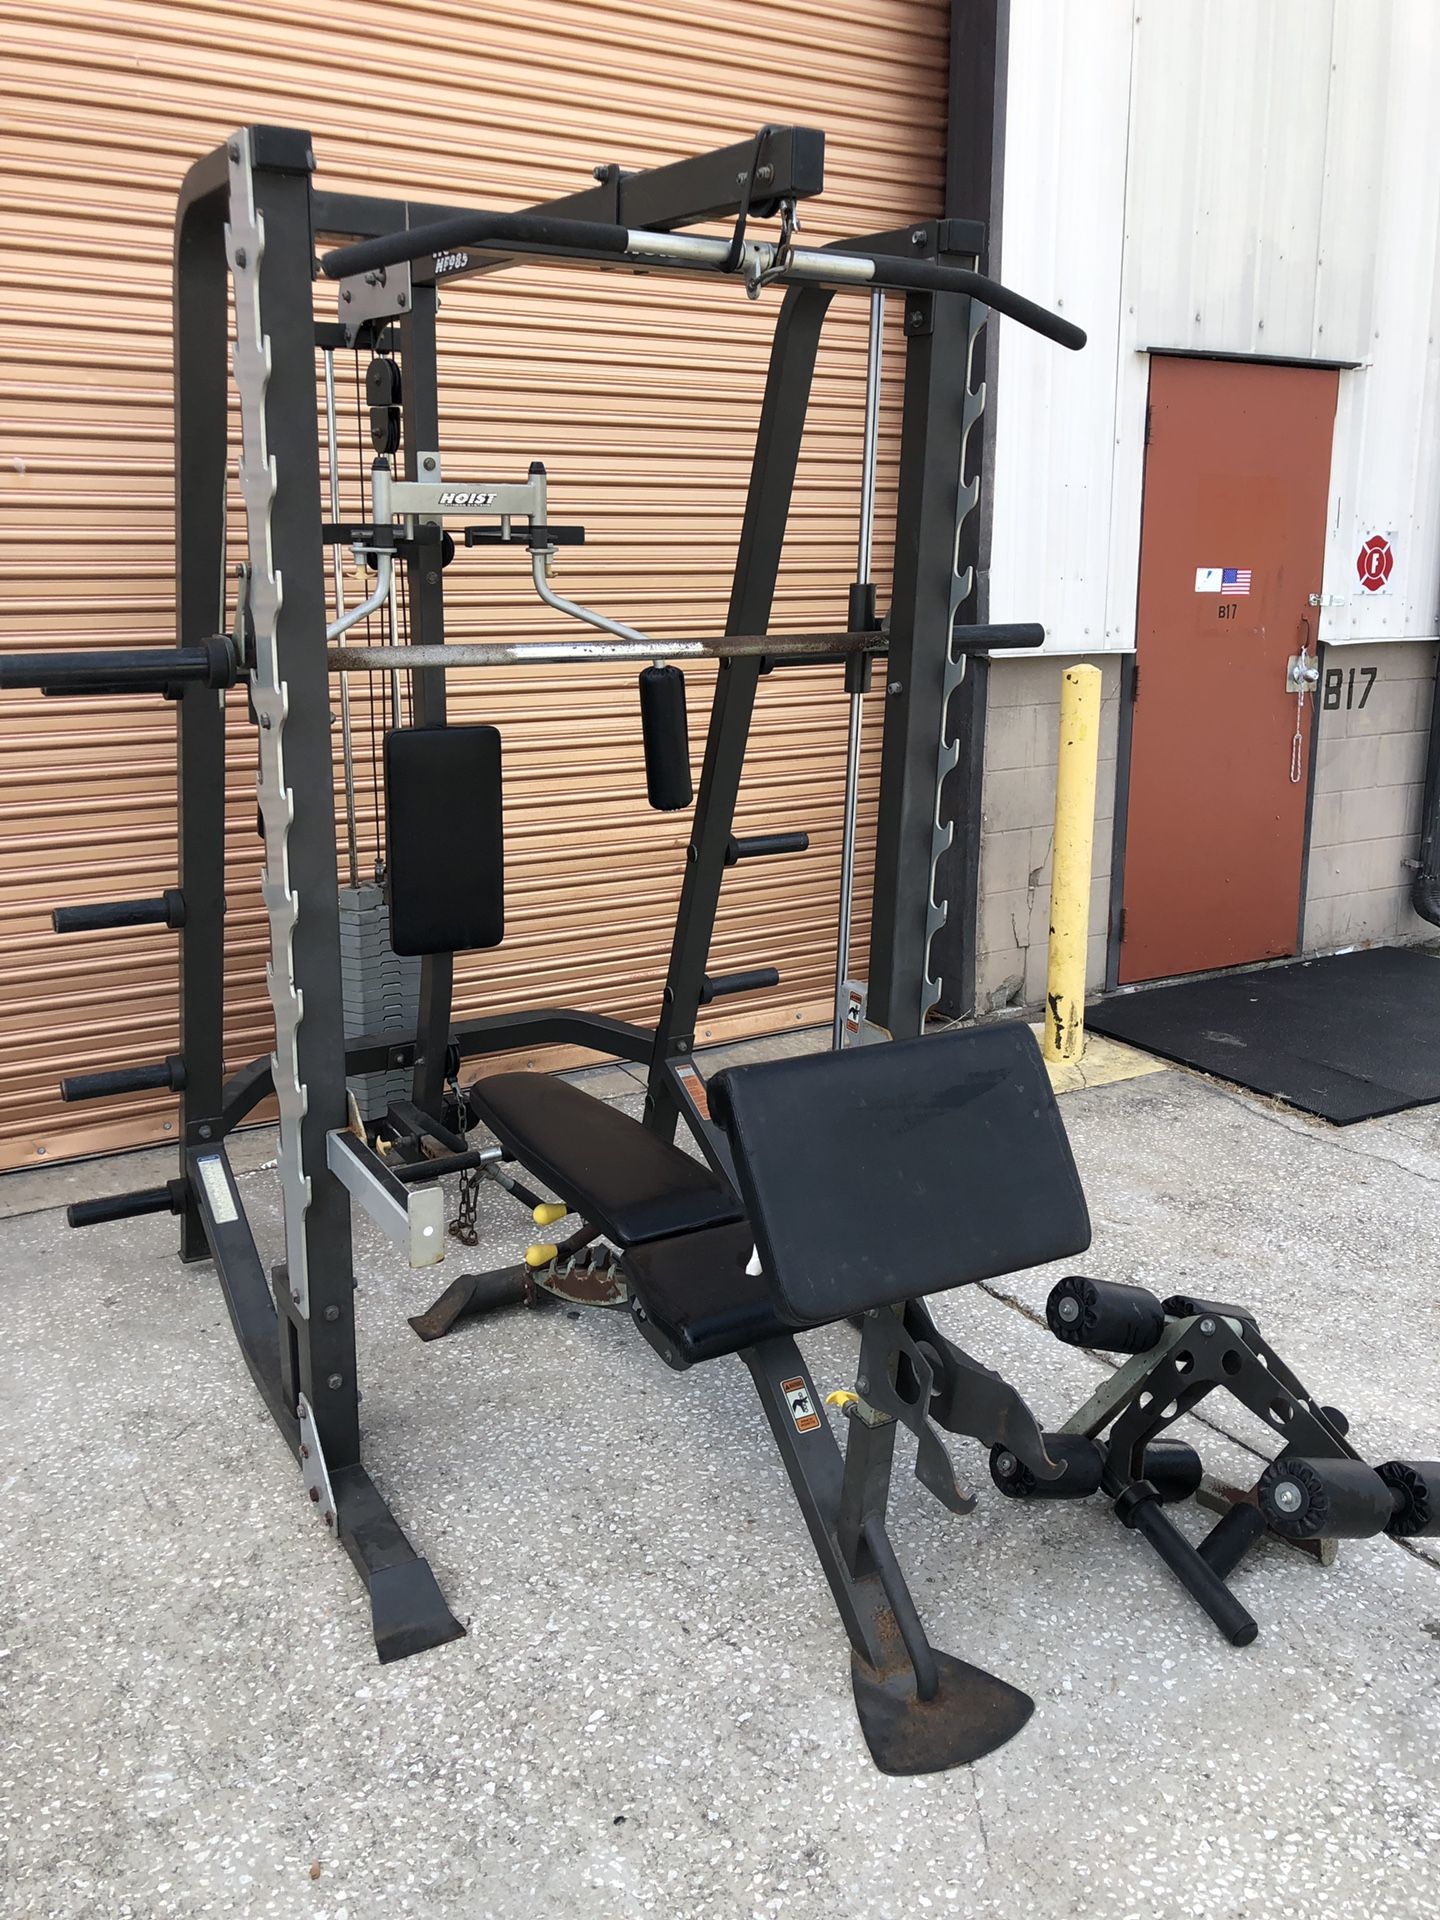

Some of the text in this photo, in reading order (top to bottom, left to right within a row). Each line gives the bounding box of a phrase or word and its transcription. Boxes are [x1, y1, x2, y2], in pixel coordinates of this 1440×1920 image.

[439, 493, 497, 504] HOIST
[1371, 553, 1379, 574] F
[1218, 604, 1237, 619] B17
[1323, 667, 1378, 710] B17
